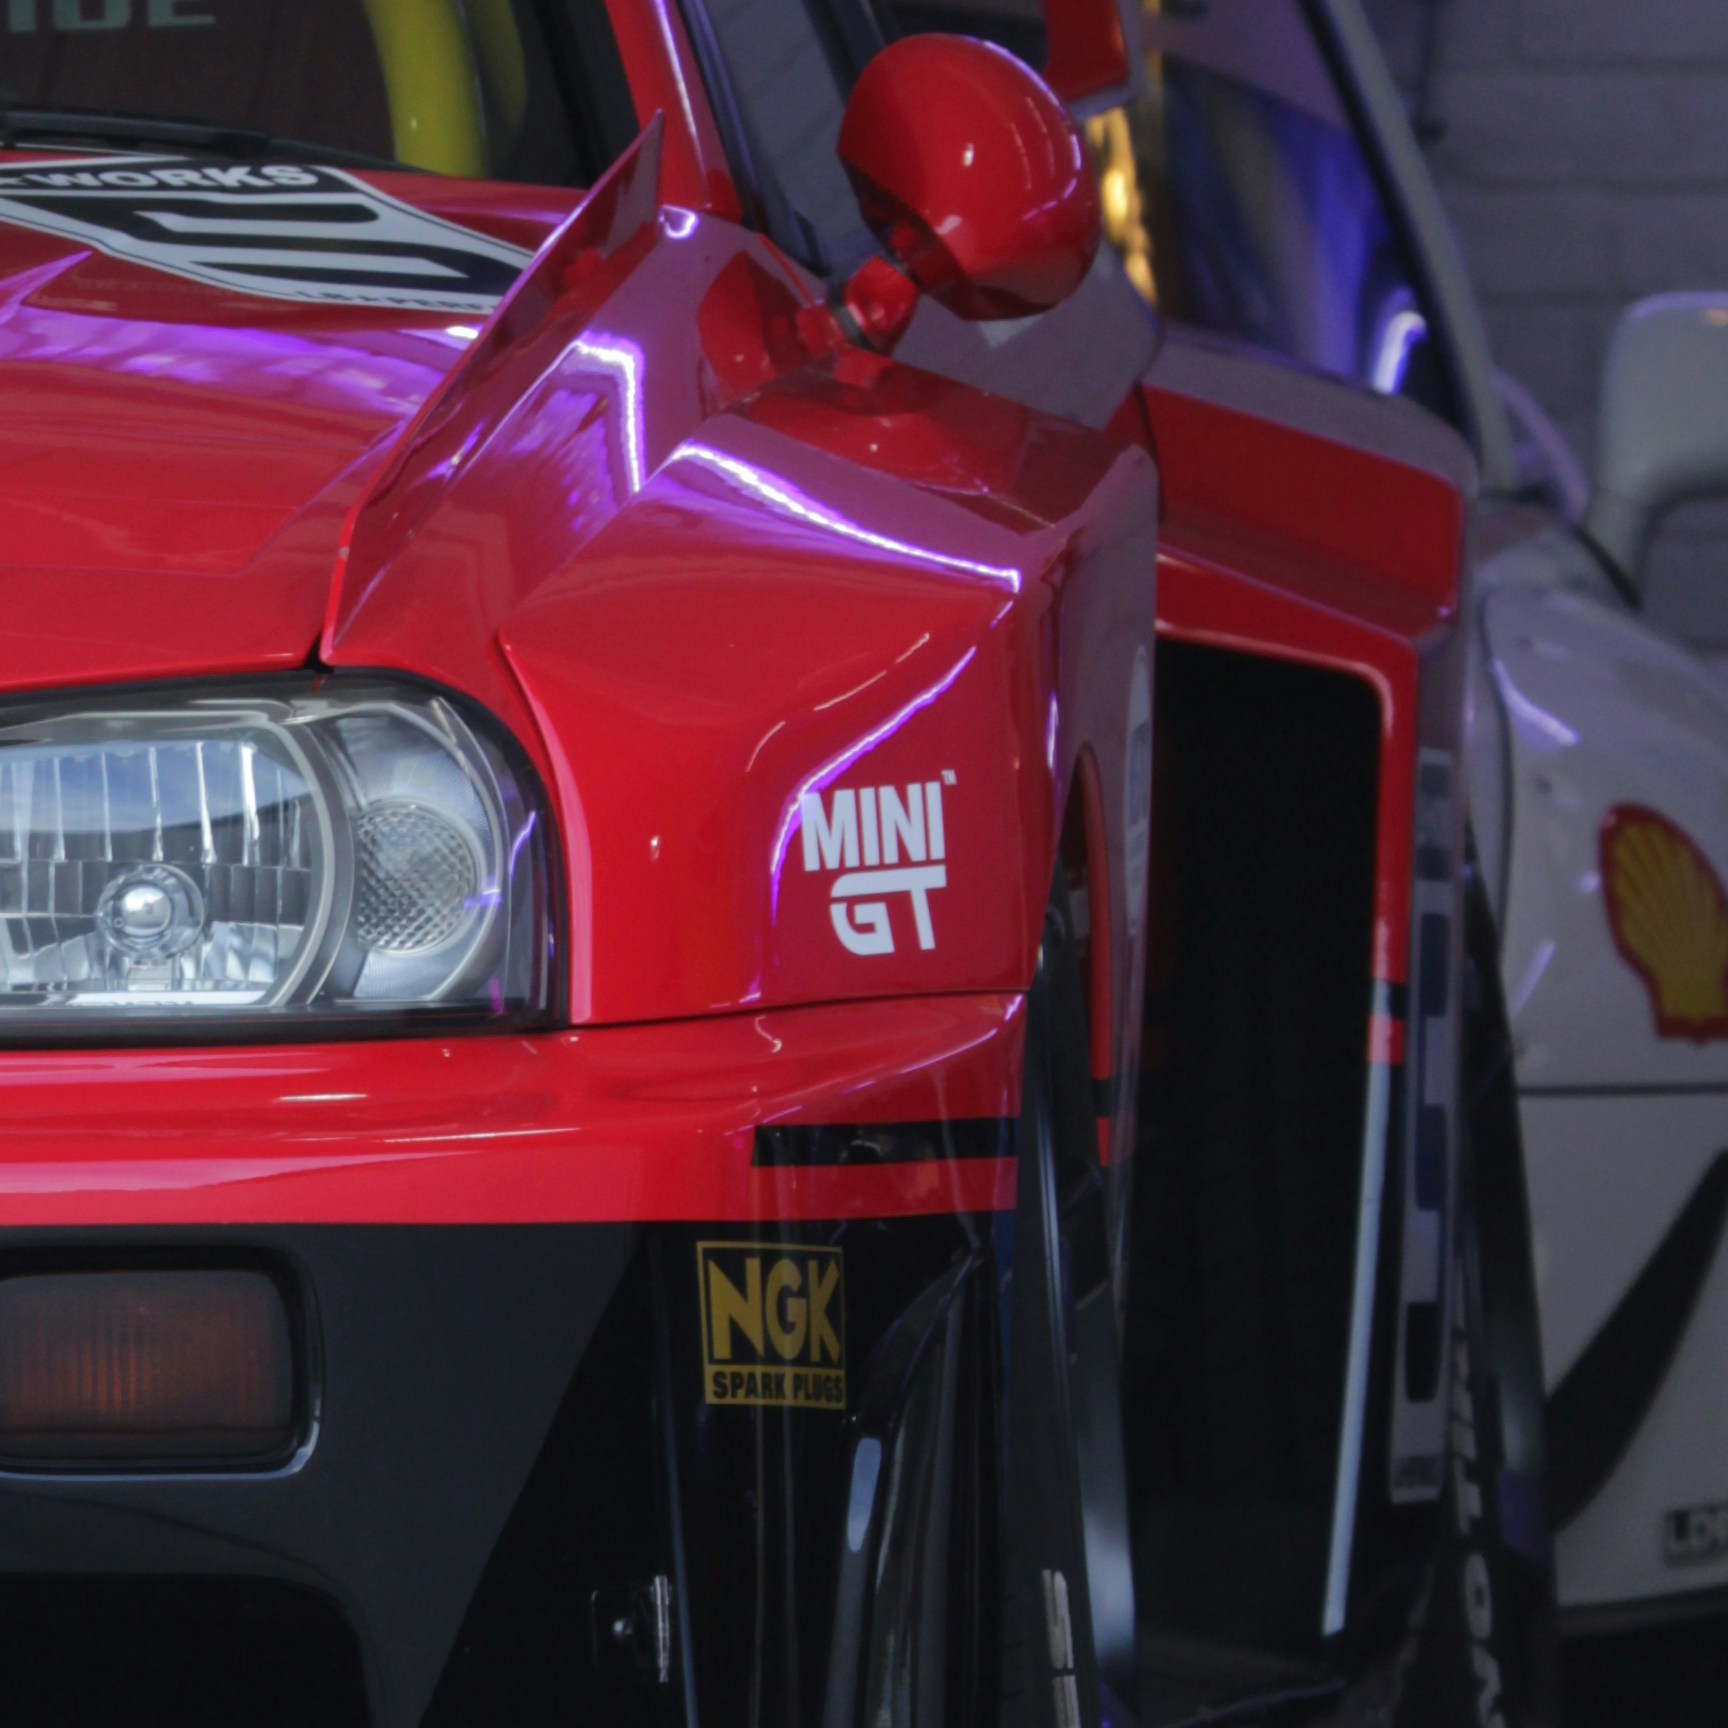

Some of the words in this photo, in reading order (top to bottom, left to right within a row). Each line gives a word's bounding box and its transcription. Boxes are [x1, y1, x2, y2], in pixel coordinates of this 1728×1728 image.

[32, 163, 321, 190] WORKS
[801, 780, 946, 873] MINI
[830, 864, 947, 957] GT
[708, 1257, 841, 1364] NGK
[712, 1371, 786, 1400] SPARK
[793, 1373, 843, 1403] PLUGS
